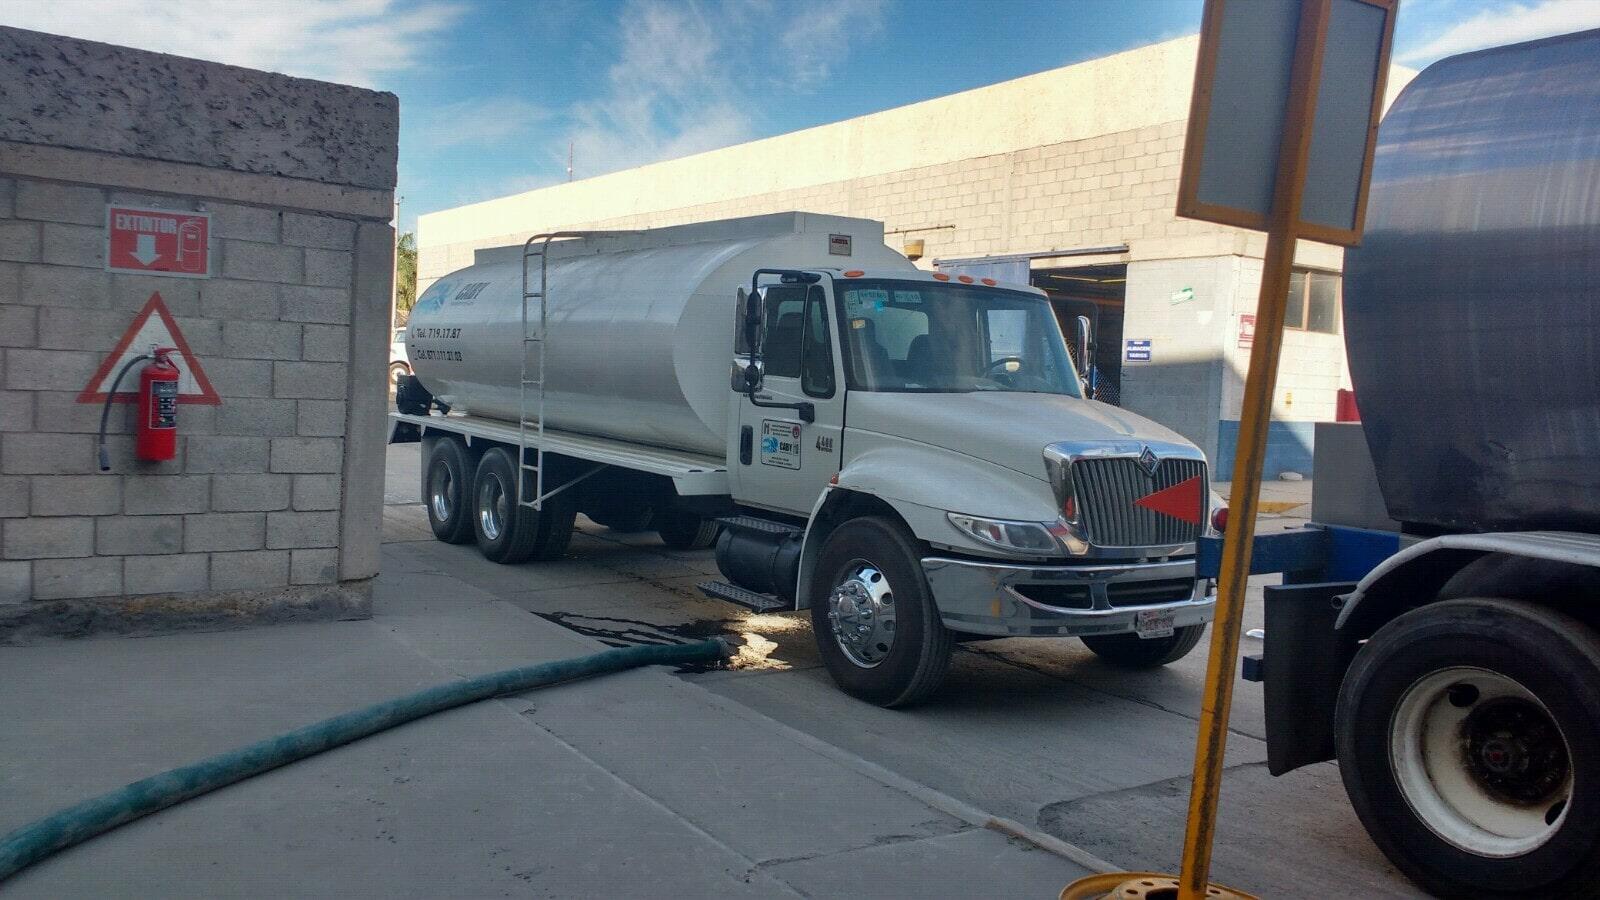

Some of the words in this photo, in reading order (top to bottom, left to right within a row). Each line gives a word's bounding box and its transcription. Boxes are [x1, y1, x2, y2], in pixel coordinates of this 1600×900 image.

[115, 213, 177, 234] EXTINTOR
[455, 282, 491, 300] CABY
[428, 328, 462, 338] 719.17.87
[779, 442, 793, 452] CABY
